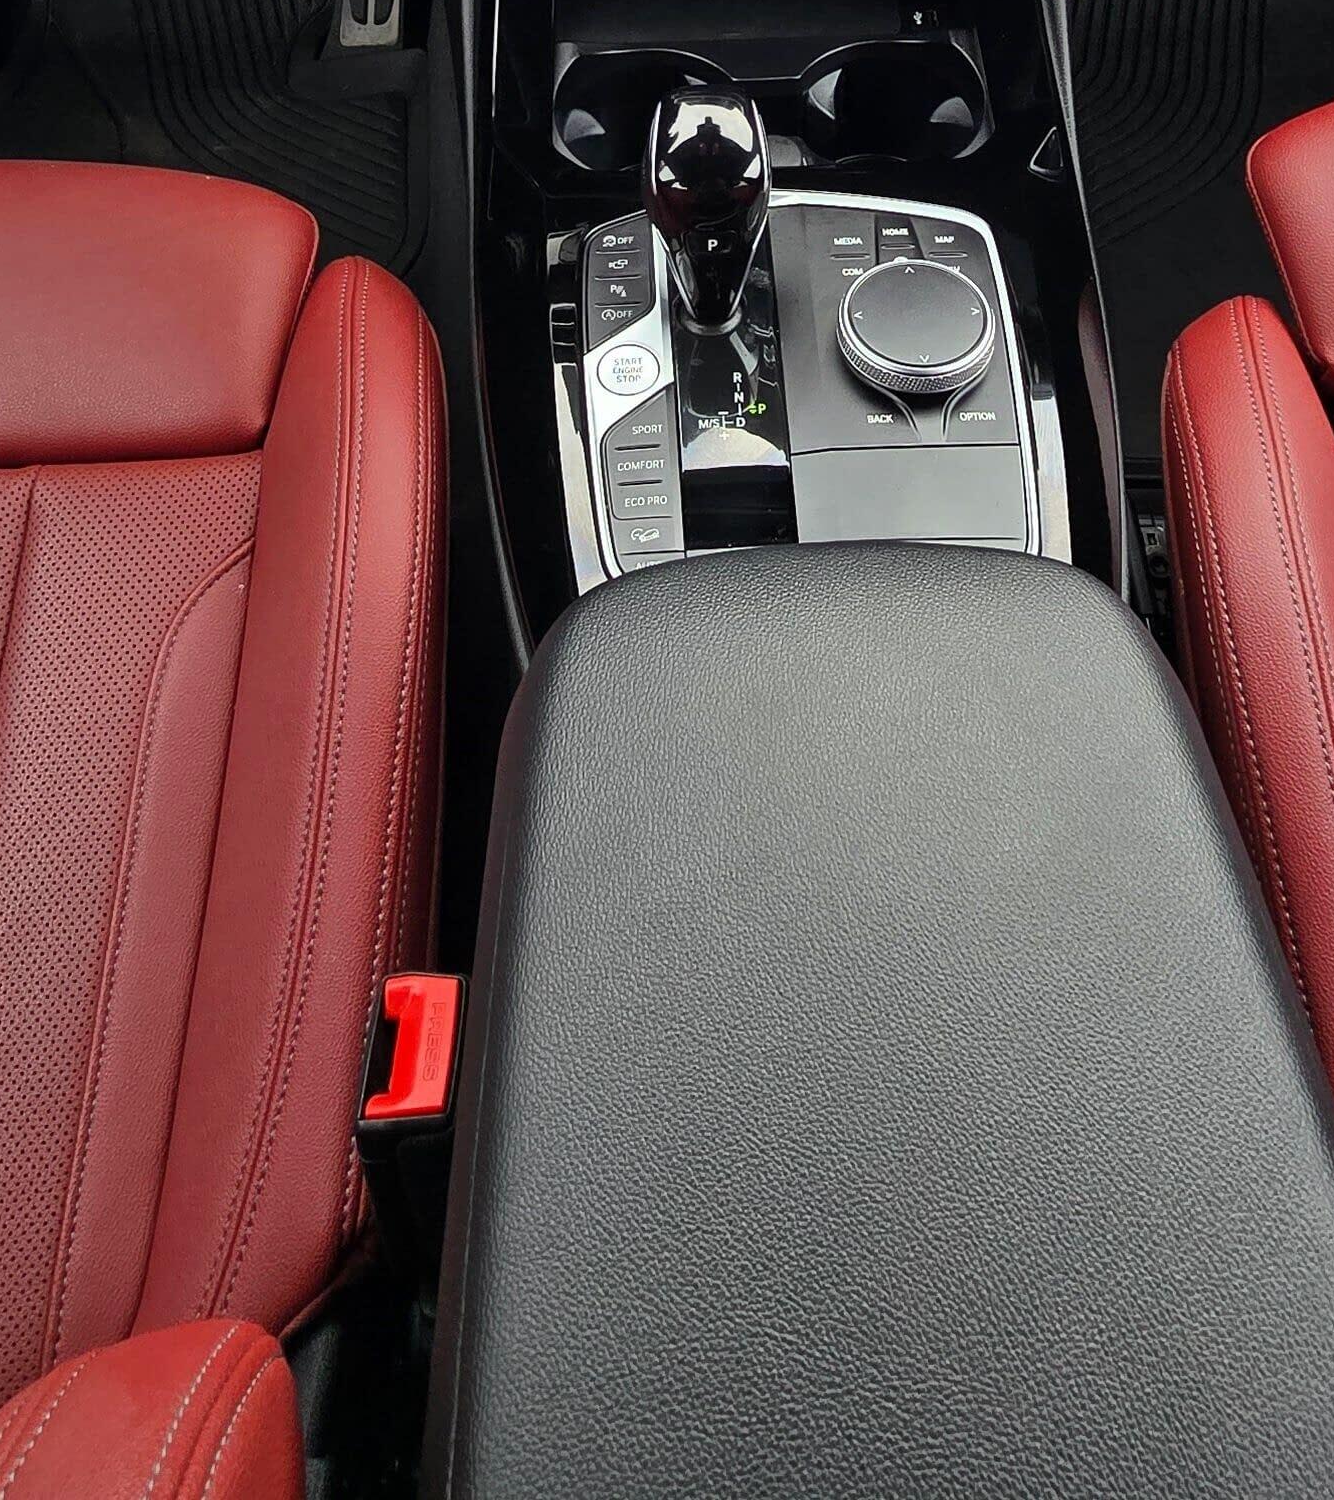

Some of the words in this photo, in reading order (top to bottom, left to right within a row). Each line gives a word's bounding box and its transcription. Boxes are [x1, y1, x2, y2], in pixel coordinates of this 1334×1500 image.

[617, 236, 634, 244] OFF
[833, 237, 863, 245] MEDIA
[934, 235, 955, 243] MAP
[708, 239, 718, 251] P
[842, 268, 864, 276] COM
[617, 310, 633, 319] OFF
[614, 357, 643, 366] START
[612, 366, 643, 374] ENGINE
[616, 374, 642, 383] STOP
[733, 372, 742, 383] R
[734, 392, 744, 403] N
[758, 404, 766, 414] P
[867, 414, 894, 424] BACK
[959, 411, 996, 421] OPTION
[698, 418, 720, 430] M/S
[736, 417, 746, 428] D
[632, 424, 663, 435] SPORT
[617, 460, 665, 471] COMFORT
[624, 497, 646, 508] ECO
[647, 495, 668, 506] PRO
[422, 1001, 447, 1082] PRESS
